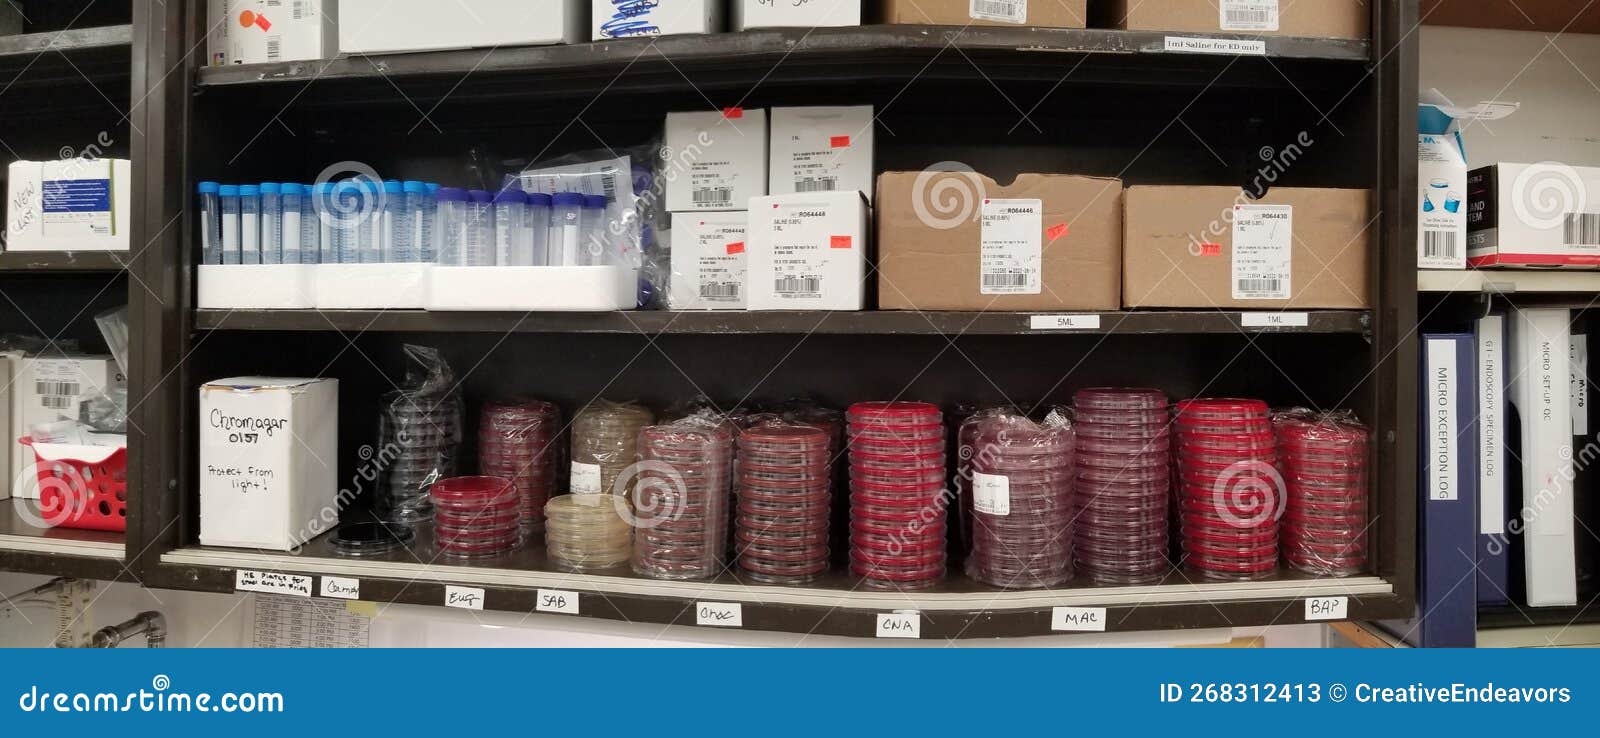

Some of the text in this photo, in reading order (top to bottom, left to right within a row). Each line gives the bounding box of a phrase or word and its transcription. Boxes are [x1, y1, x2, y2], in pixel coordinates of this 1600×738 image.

[1185, 41, 1212, 49] Saline
[1213, 42, 1227, 50] for
[1057, 318, 1075, 326] 5ML
[1268, 315, 1283, 324] 1ML
[1543, 342, 1551, 370] MICRO
[1485, 360, 1494, 410] ENDOSCOPY
[210, 408, 288, 437] Chromagar
[1438, 368, 1449, 499] MICRO EXCEPTION LOG
[1485, 414, 1495, 456] SPECIMEN
[1486, 459, 1495, 477] LOG
[542, 595, 567, 609] SAB
[1311, 599, 1340, 615] BAP
[883, 618, 913, 632] CNA
[1065, 612, 1097, 625] MAC
